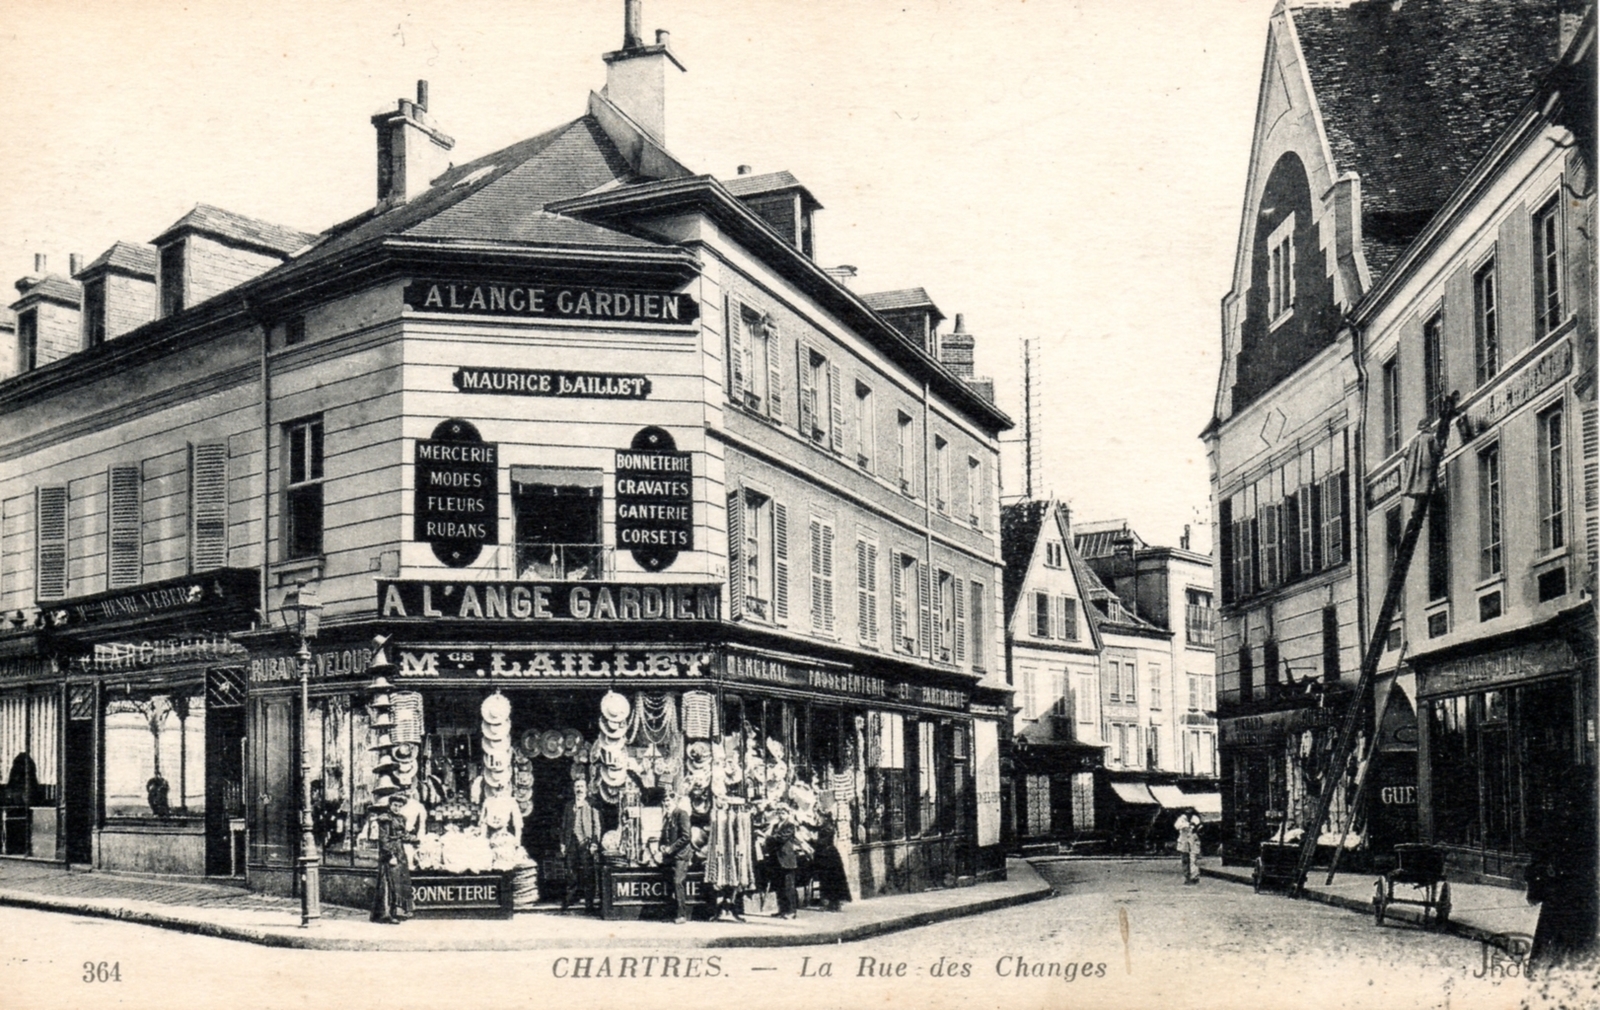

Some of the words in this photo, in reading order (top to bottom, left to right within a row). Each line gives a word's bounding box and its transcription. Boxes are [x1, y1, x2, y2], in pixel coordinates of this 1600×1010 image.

[424, 284, 443, 307] A
[556, 289, 680, 319] GARDIEN
[462, 371, 551, 392] MAURICE
[557, 375, 646, 396] LAILLET
[418, 444, 495, 463] MERCERIE
[616, 453, 691, 473] BONNETERIE
[430, 470, 482, 488] MODES
[617, 479, 690, 497] CRAVATES
[428, 496, 485, 513] FLEURS
[618, 504, 689, 521] GANTERIE
[426, 522, 487, 539] RUBANS
[621, 528, 688, 545] CORSETS
[101, 595, 139, 618] HENRI
[382, 584, 408, 617] A
[423, 584, 554, 619] L'ANGE
[569, 586, 719, 620] GARDIEN
[316, 648, 373, 677] VELOUR
[491, 651, 710, 677] LAILLET
[411, 884, 497, 901] BONNETERIE
